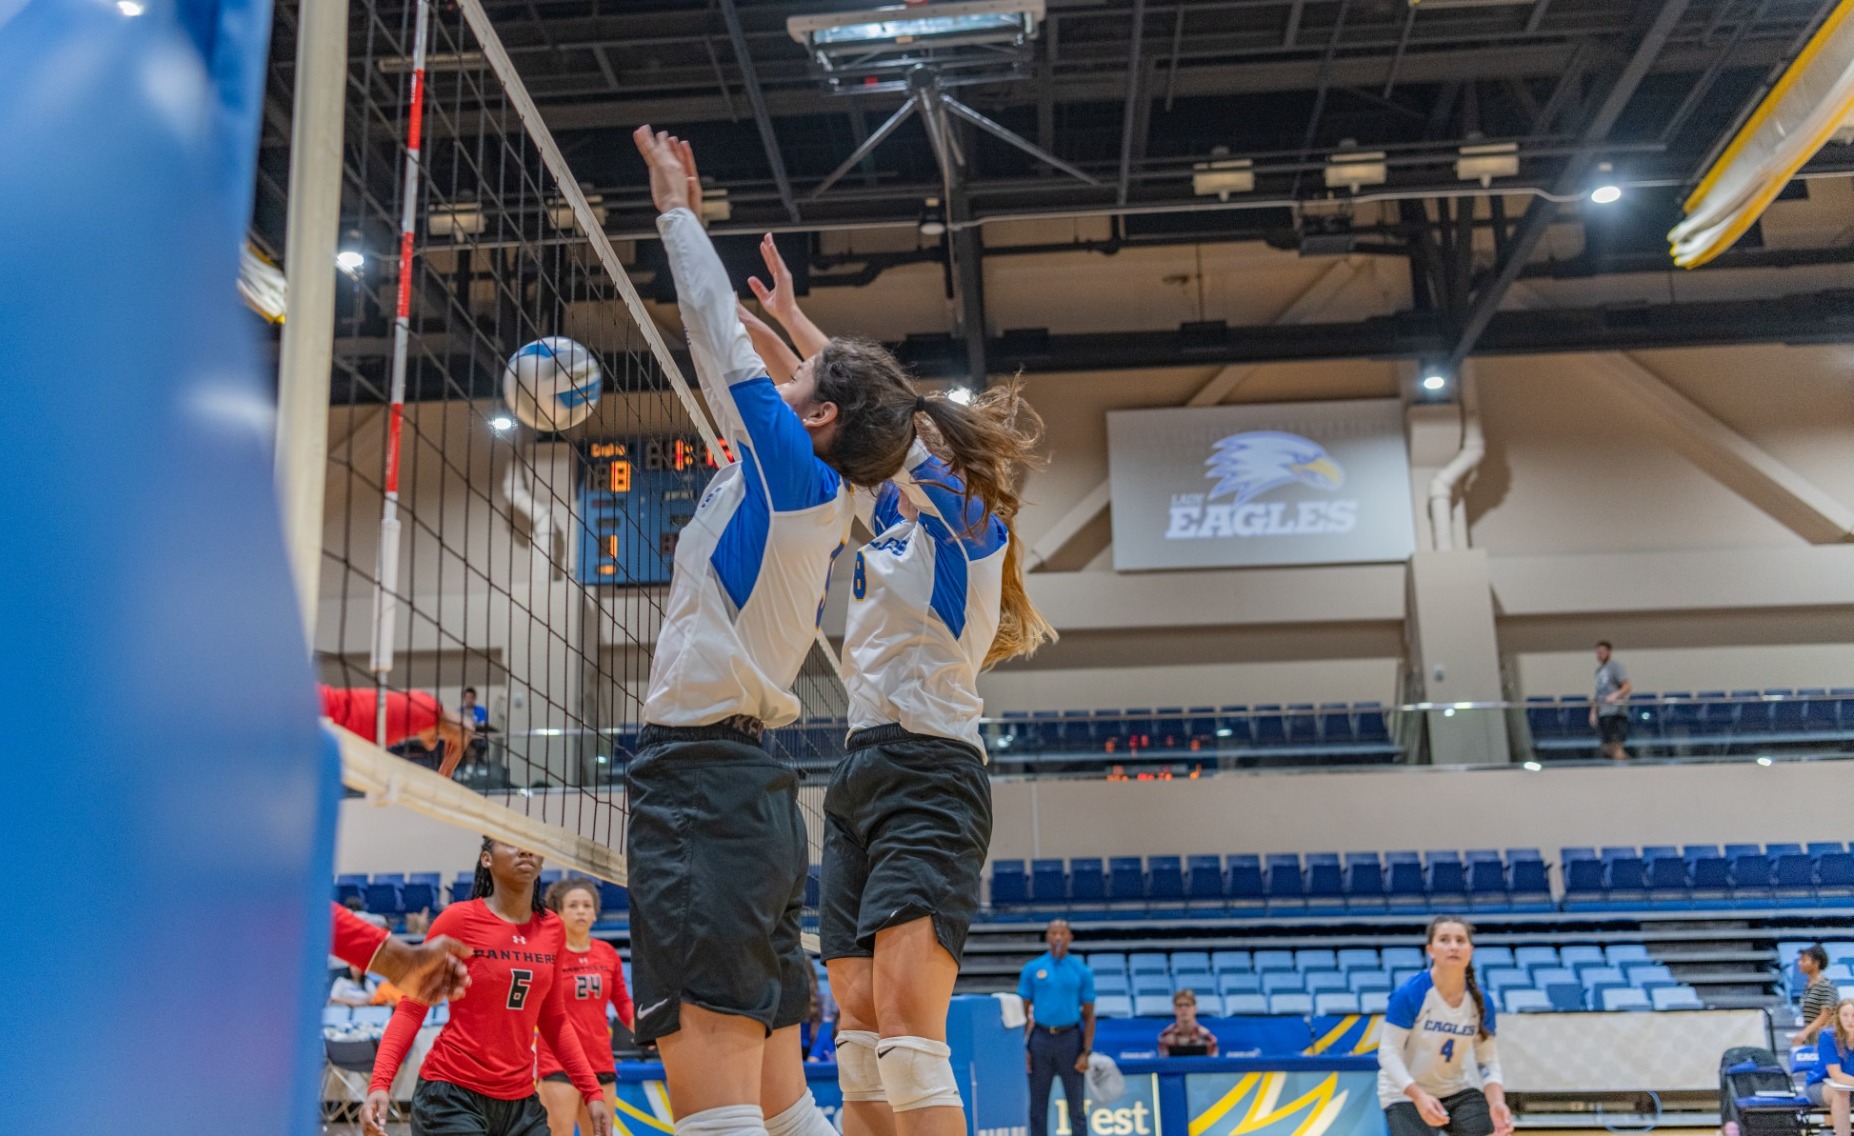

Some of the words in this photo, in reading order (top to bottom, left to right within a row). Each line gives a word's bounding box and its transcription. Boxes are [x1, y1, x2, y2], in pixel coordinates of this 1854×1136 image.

[1165, 500, 1358, 539] EAGLES
[507, 969, 533, 1010] 6
[574, 973, 602, 1000] 24
[1424, 1020, 1476, 1036] EAGLES
[1440, 1039, 1455, 1063] 4
